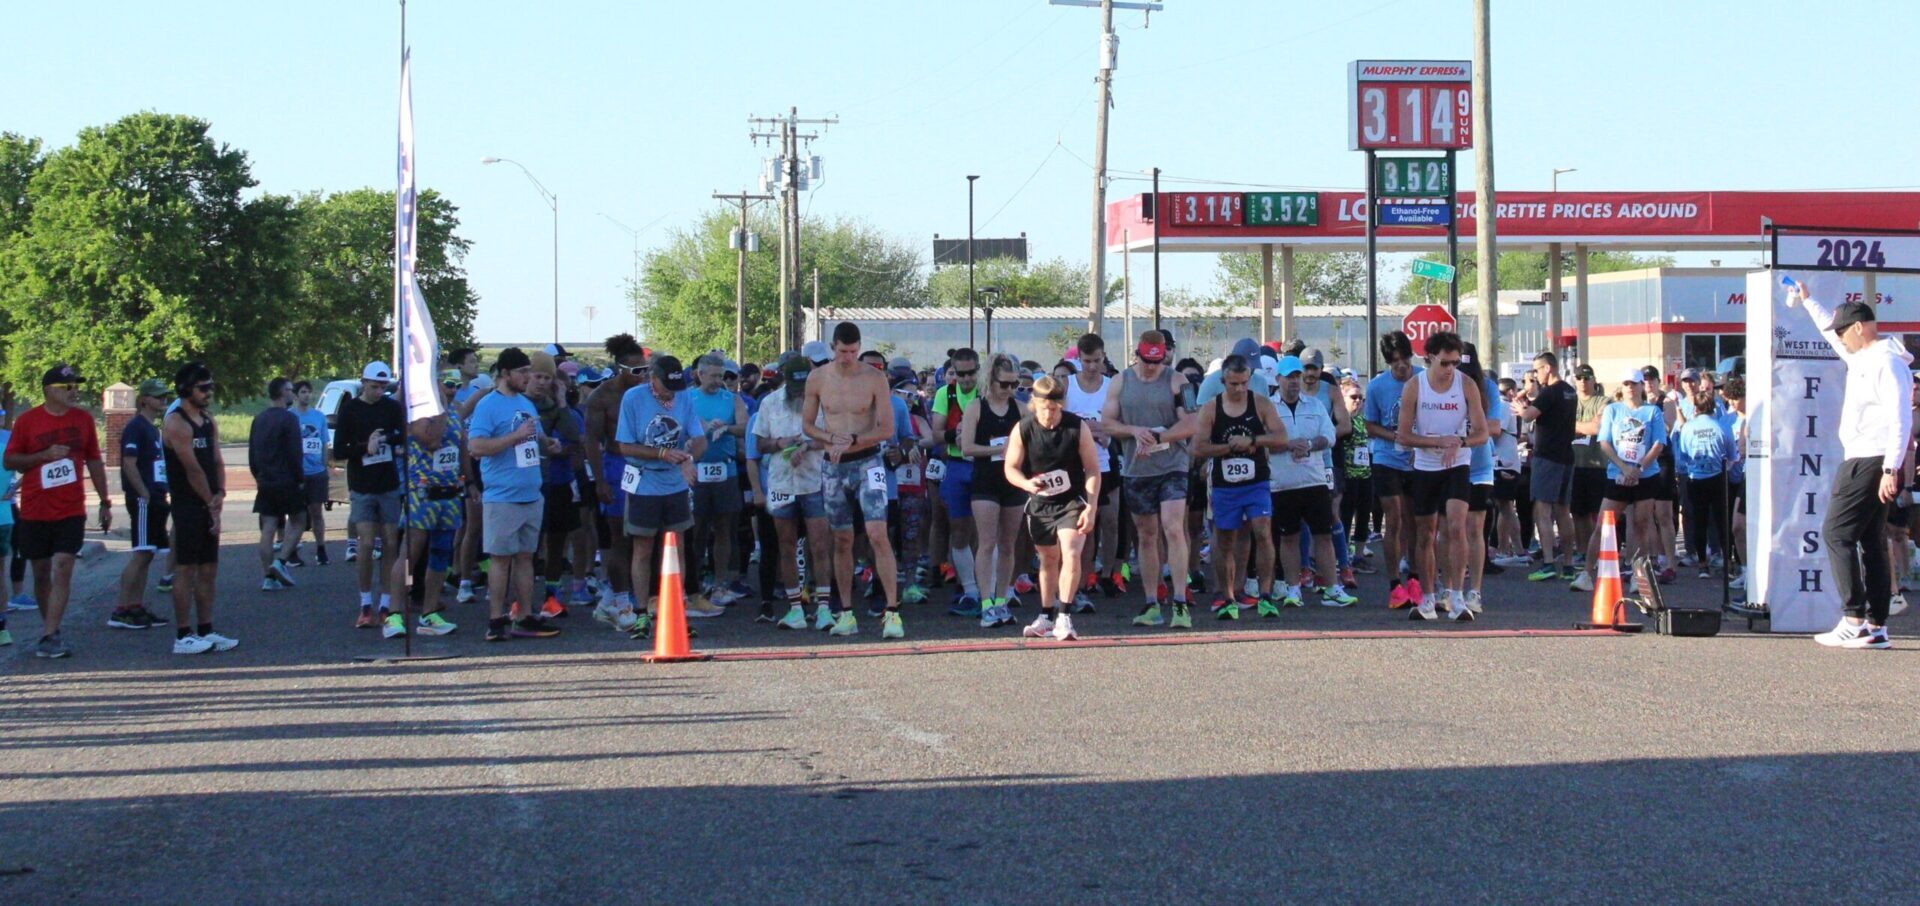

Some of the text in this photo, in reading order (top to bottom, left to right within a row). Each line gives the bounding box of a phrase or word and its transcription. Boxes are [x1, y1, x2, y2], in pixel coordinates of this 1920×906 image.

[1362, 66, 1458, 76] MURPHY EXPRESS
[1391, 207, 1440, 215] Ethanol-Free
[1551, 203, 1612, 218] PRICES
[1617, 203, 1698, 218] AROUND
[1398, 215, 1434, 223] Available
[1817, 239, 1885, 268] 2024
[1784, 341, 1809, 350] WEST
[1421, 403, 1458, 411] RUNLBK
[306, 441, 320, 450] 231
[439, 451, 457, 464] 238
[524, 448, 536, 460] 81
[1625, 450, 1637, 460] 83
[703, 466, 722, 476] 125
[906, 469, 913, 479] 8
[1226, 464, 1249, 476] 293
[1799, 377, 1823, 593] FINISH
